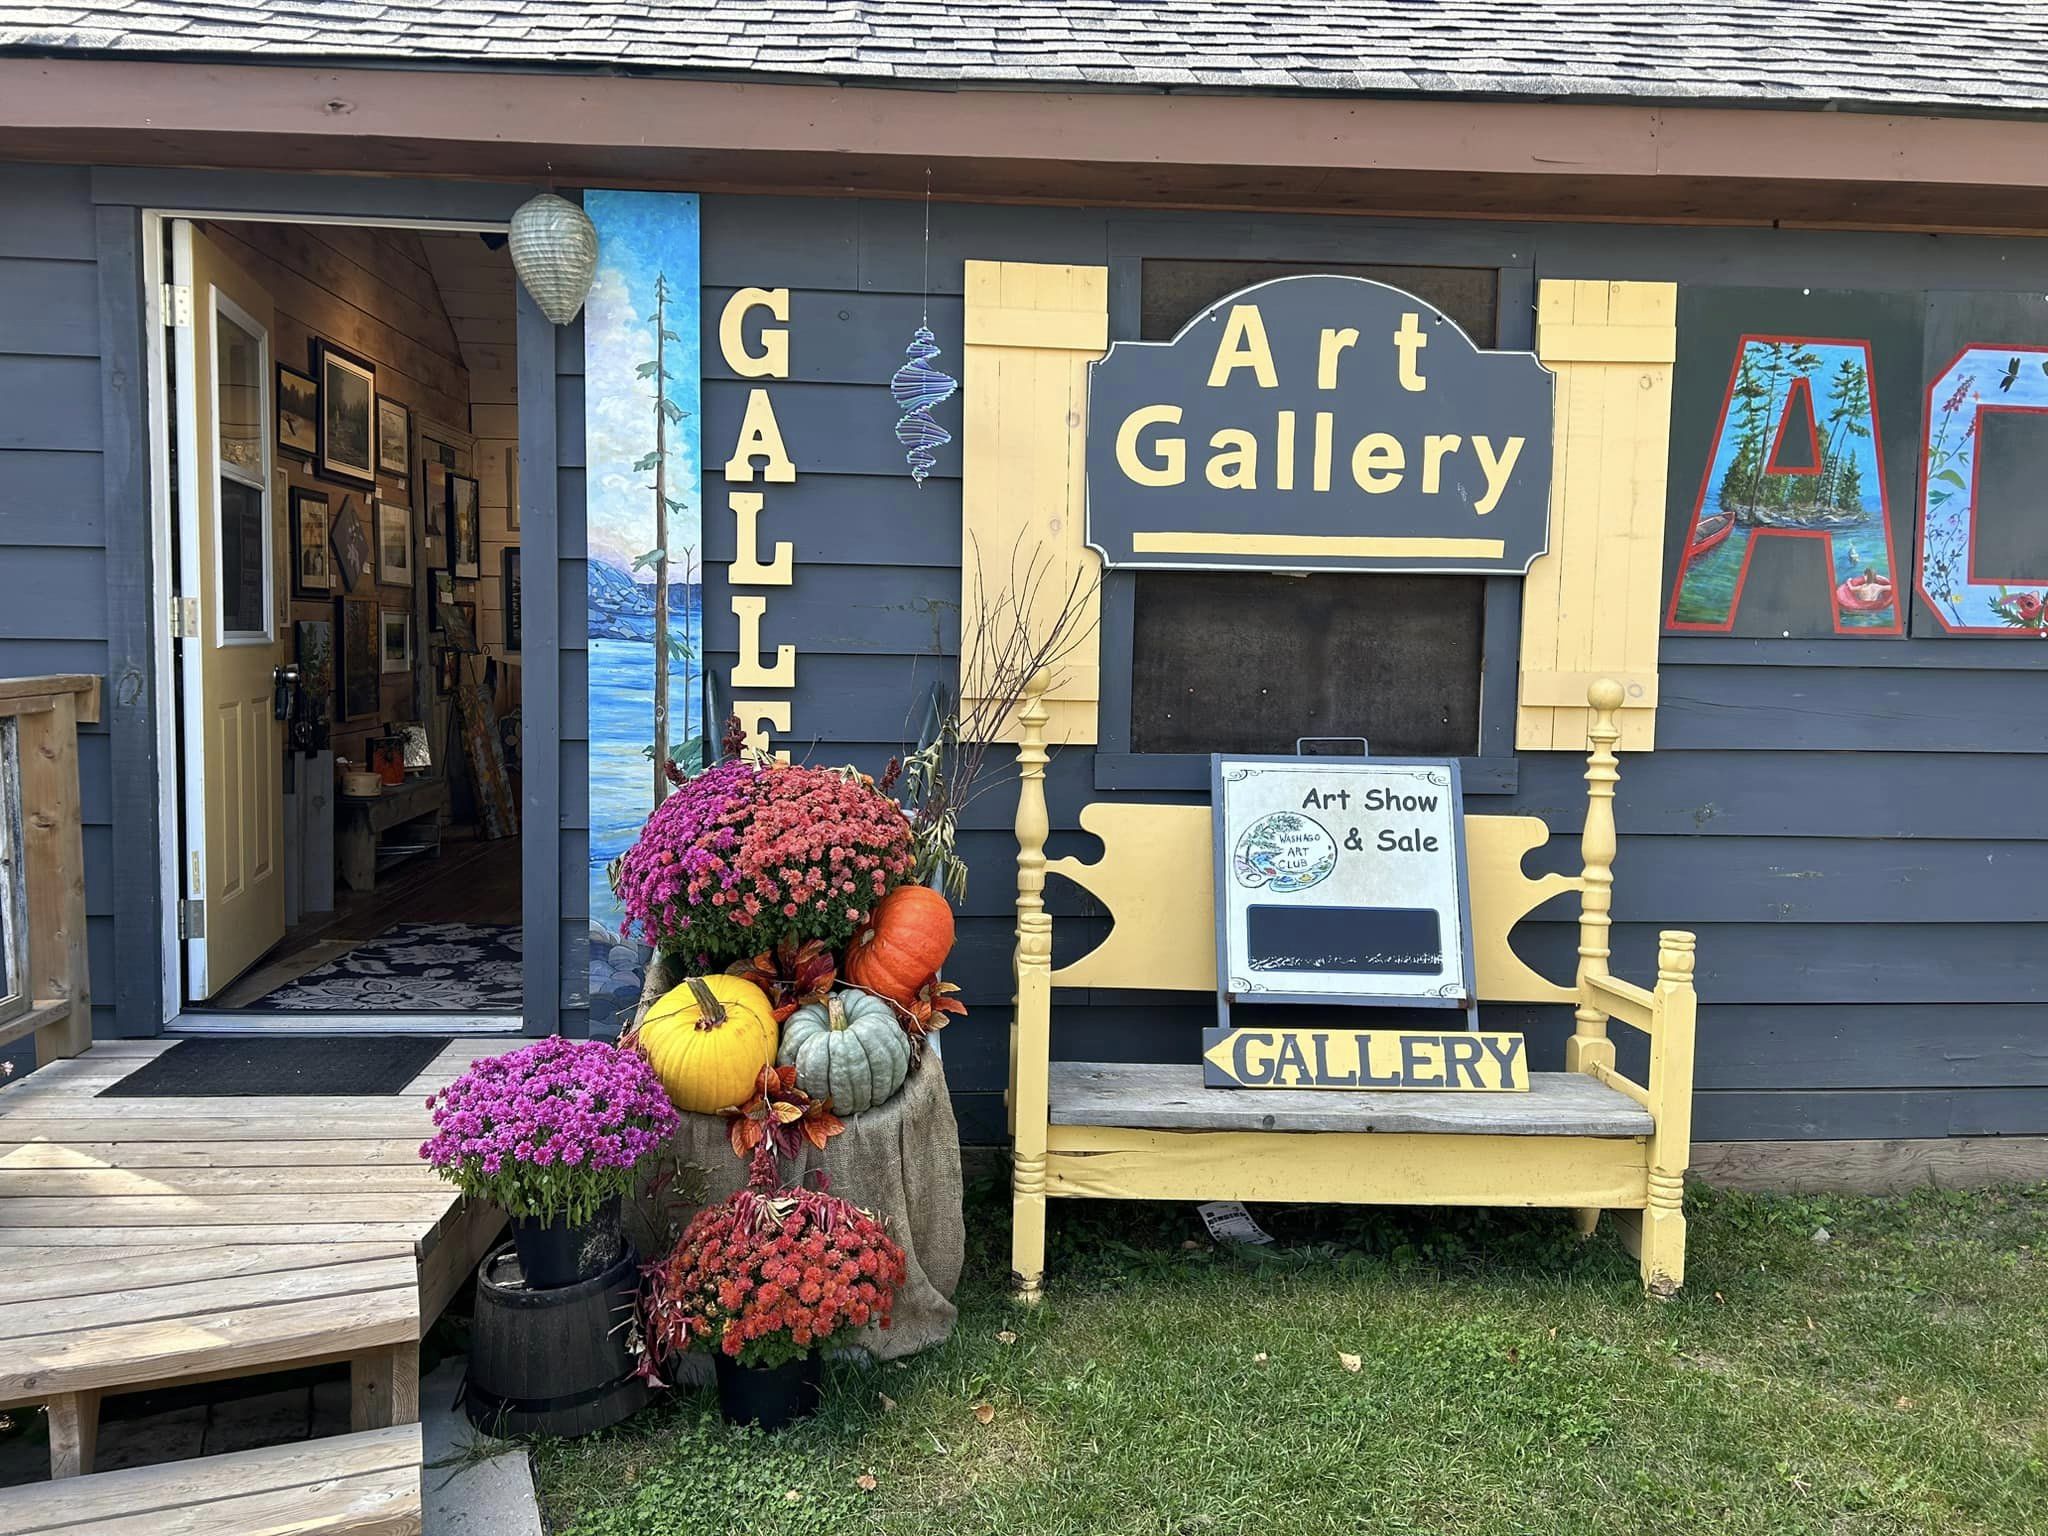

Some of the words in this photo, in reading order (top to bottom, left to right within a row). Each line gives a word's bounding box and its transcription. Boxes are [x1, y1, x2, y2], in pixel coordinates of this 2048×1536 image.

[1207, 304, 1428, 392] Art
[1115, 404, 1525, 515] Gallery
[1302, 787, 1351, 810] Art
[1364, 787, 1438, 812] Show
[1280, 833, 1321, 845] WASHAGO
[1344, 827, 1363, 851] &
[1377, 828, 1438, 852] Sale
[1278, 859, 1308, 869] CLUB
[1287, 847, 1309, 857] ART
[1232, 1033, 1523, 1089] GALLERY
